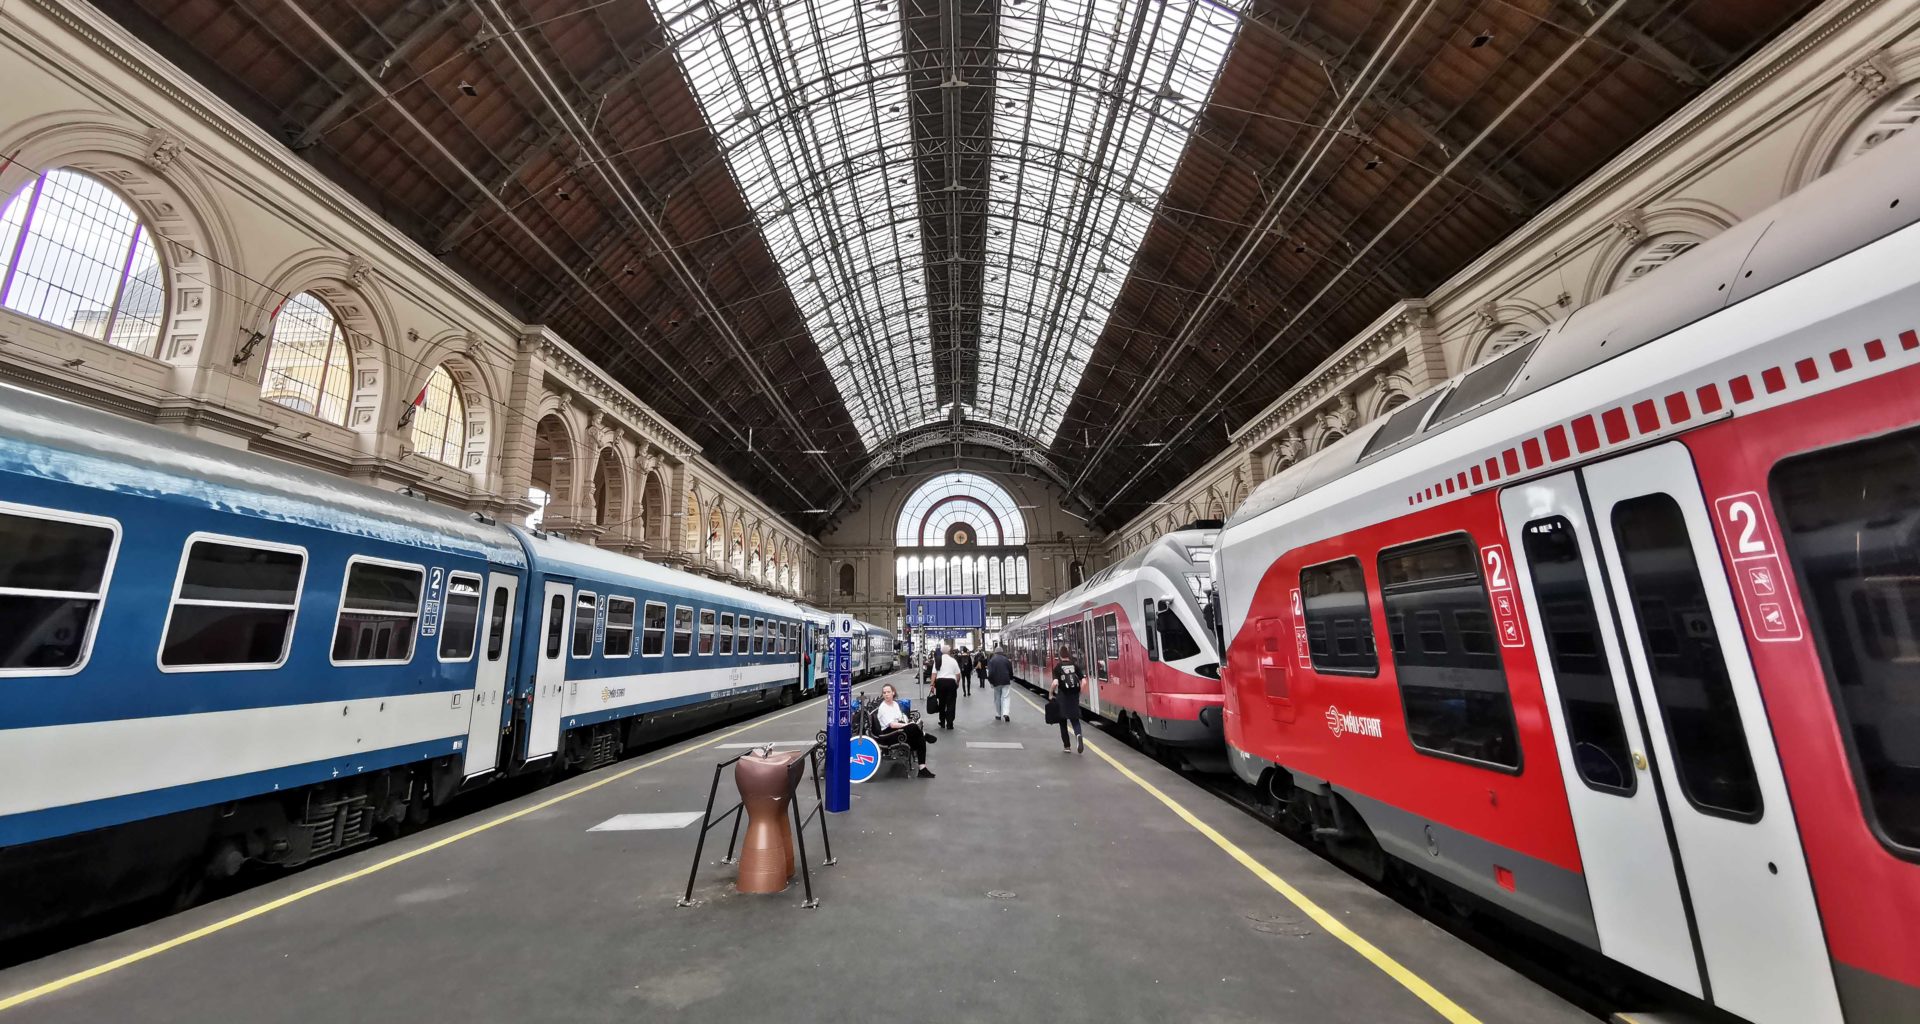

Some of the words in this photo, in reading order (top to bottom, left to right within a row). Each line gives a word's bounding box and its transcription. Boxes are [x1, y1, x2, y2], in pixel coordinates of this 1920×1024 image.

[1729, 501, 1765, 553] 2
[431, 569, 441, 590] 2
[1487, 550, 1506, 587] 2
[599, 597, 604, 611] 2
[1292, 591, 1301, 616] 2
